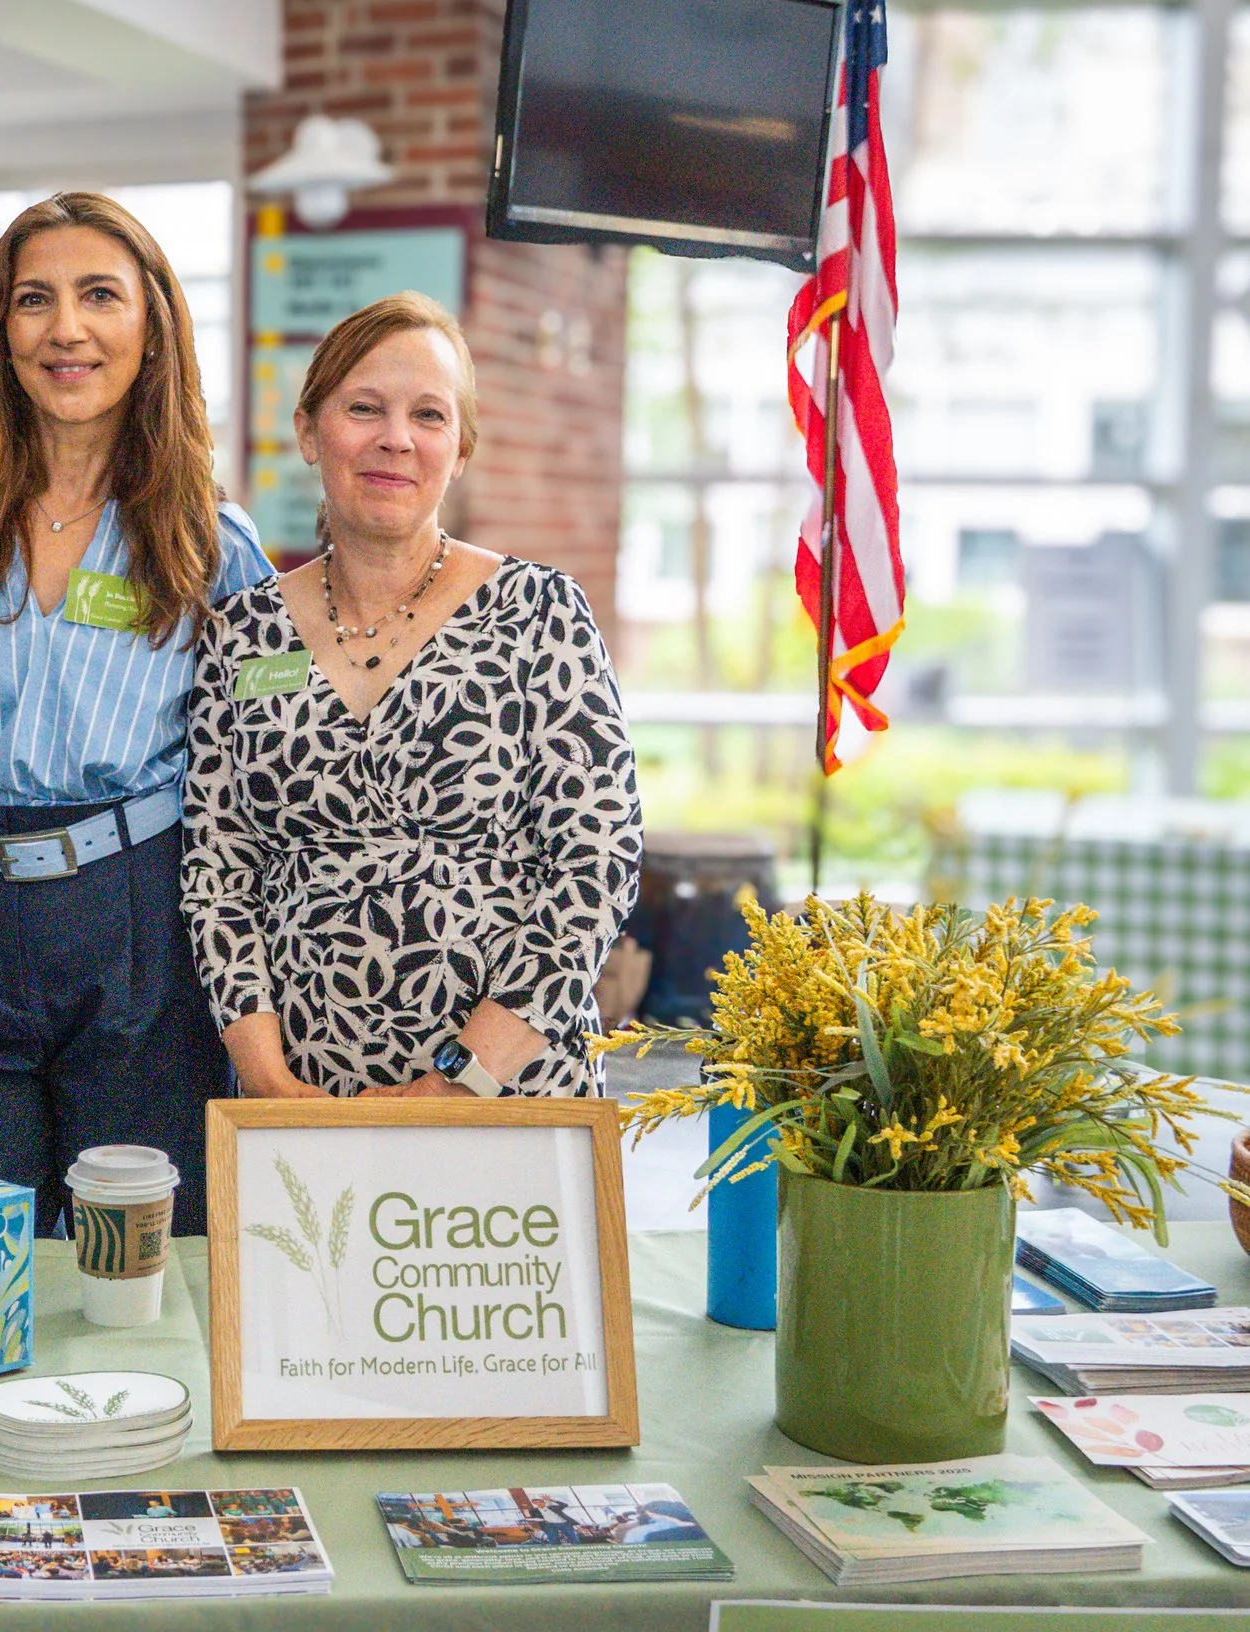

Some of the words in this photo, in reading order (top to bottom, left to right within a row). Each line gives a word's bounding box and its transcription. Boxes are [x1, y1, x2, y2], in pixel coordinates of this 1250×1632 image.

[269, 668, 299, 680] Hello!
[368, 1191, 559, 1250] Grace
[372, 1253, 561, 1294] Community
[373, 1290, 567, 1342] Church
[280, 1357, 323, 1377] Faith
[327, 1358, 355, 1380] for
[361, 1356, 437, 1376] Modern
[442, 1355, 479, 1376] Life,
[483, 1354, 536, 1374] Grace
[542, 1354, 569, 1375] for
[575, 1352, 597, 1372] All
[854, 1469, 936, 1479] PARTNERS
[138, 1524, 196, 1533] Grace
[140, 1535, 200, 1543] Church
